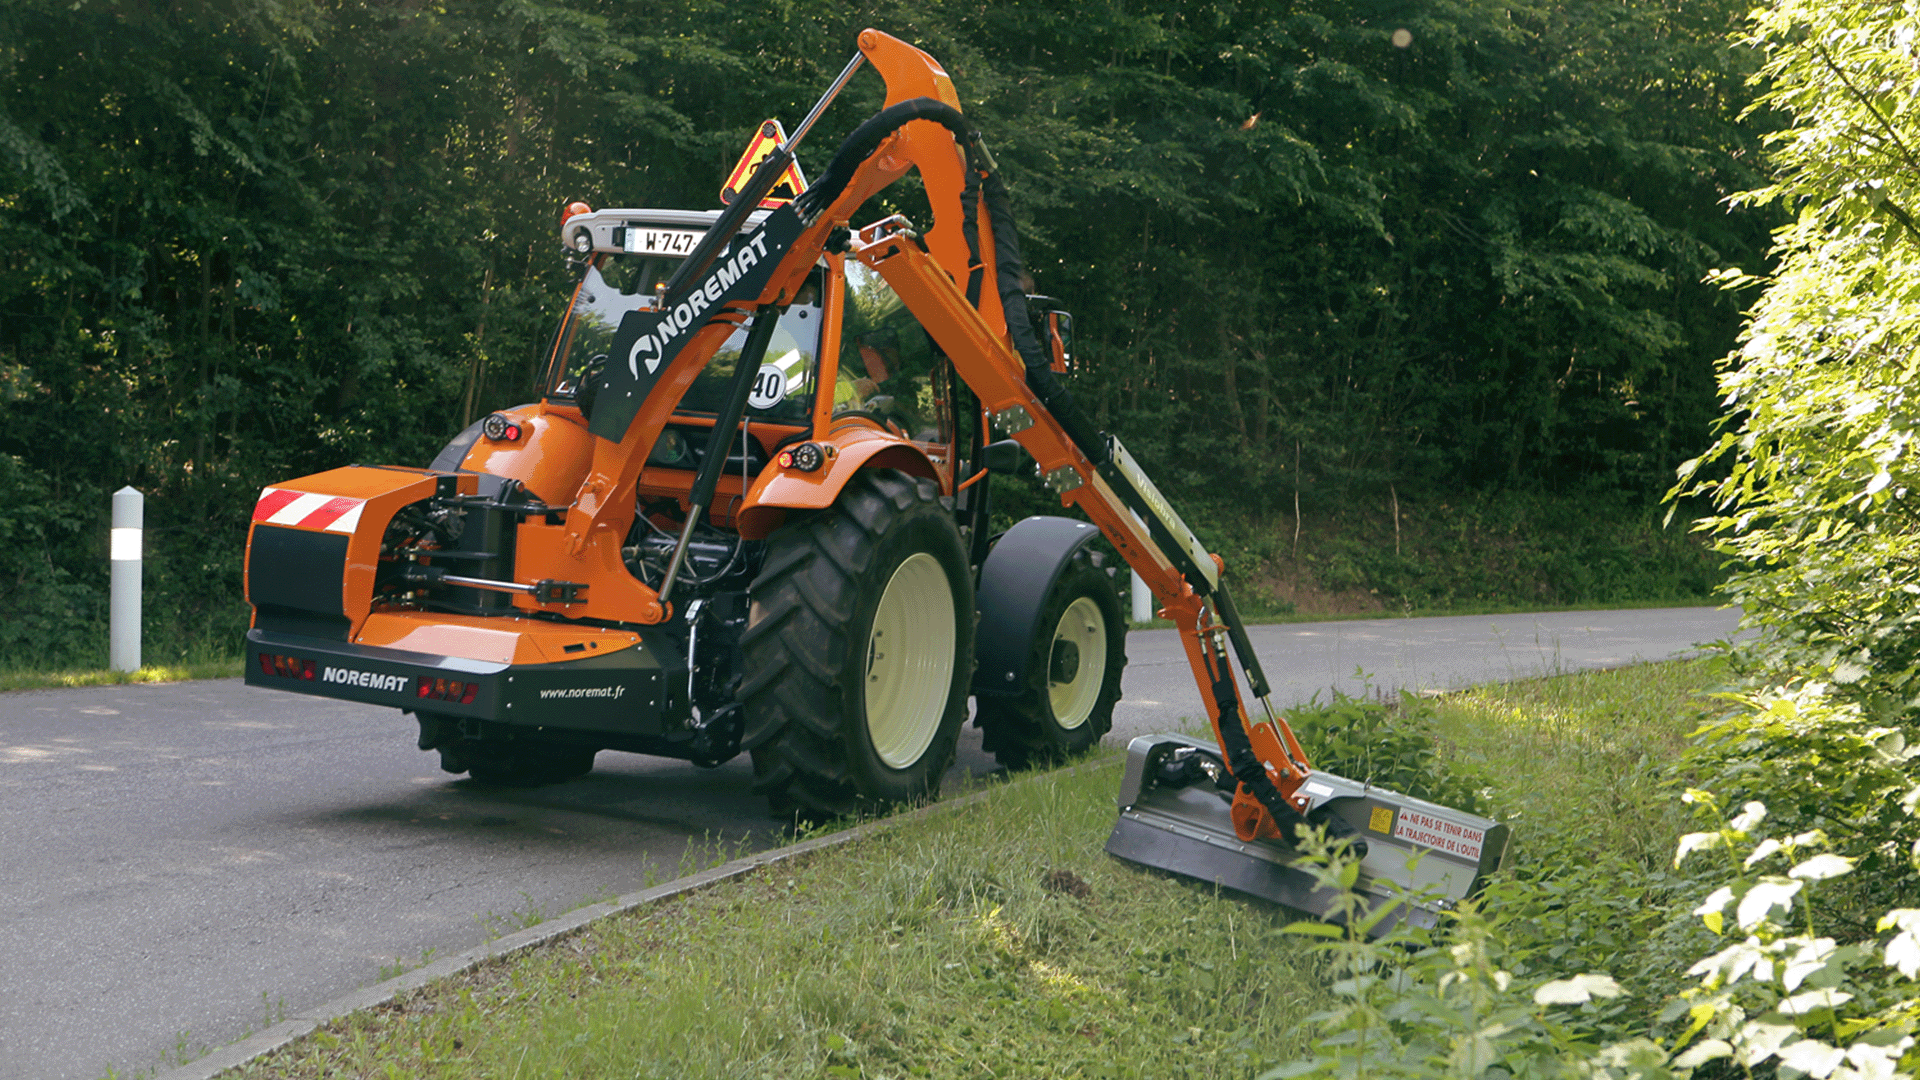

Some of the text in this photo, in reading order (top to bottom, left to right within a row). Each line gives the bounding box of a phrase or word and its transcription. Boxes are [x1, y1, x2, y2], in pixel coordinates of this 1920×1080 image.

[645, 231, 698, 253] W-747-
[656, 231, 769, 346] NOREMAT
[752, 372, 780, 399] 40
[323, 666, 409, 692] NOREMAT
[540, 684, 625, 700] www.noremat.fr
[1395, 825, 1404, 836] LA
[1405, 827, 1446, 849] TRAJECTOIRE
[1446, 840, 1456, 851] DE
[1410, 813, 1482, 843] NE PAS SE TENIR DANS
